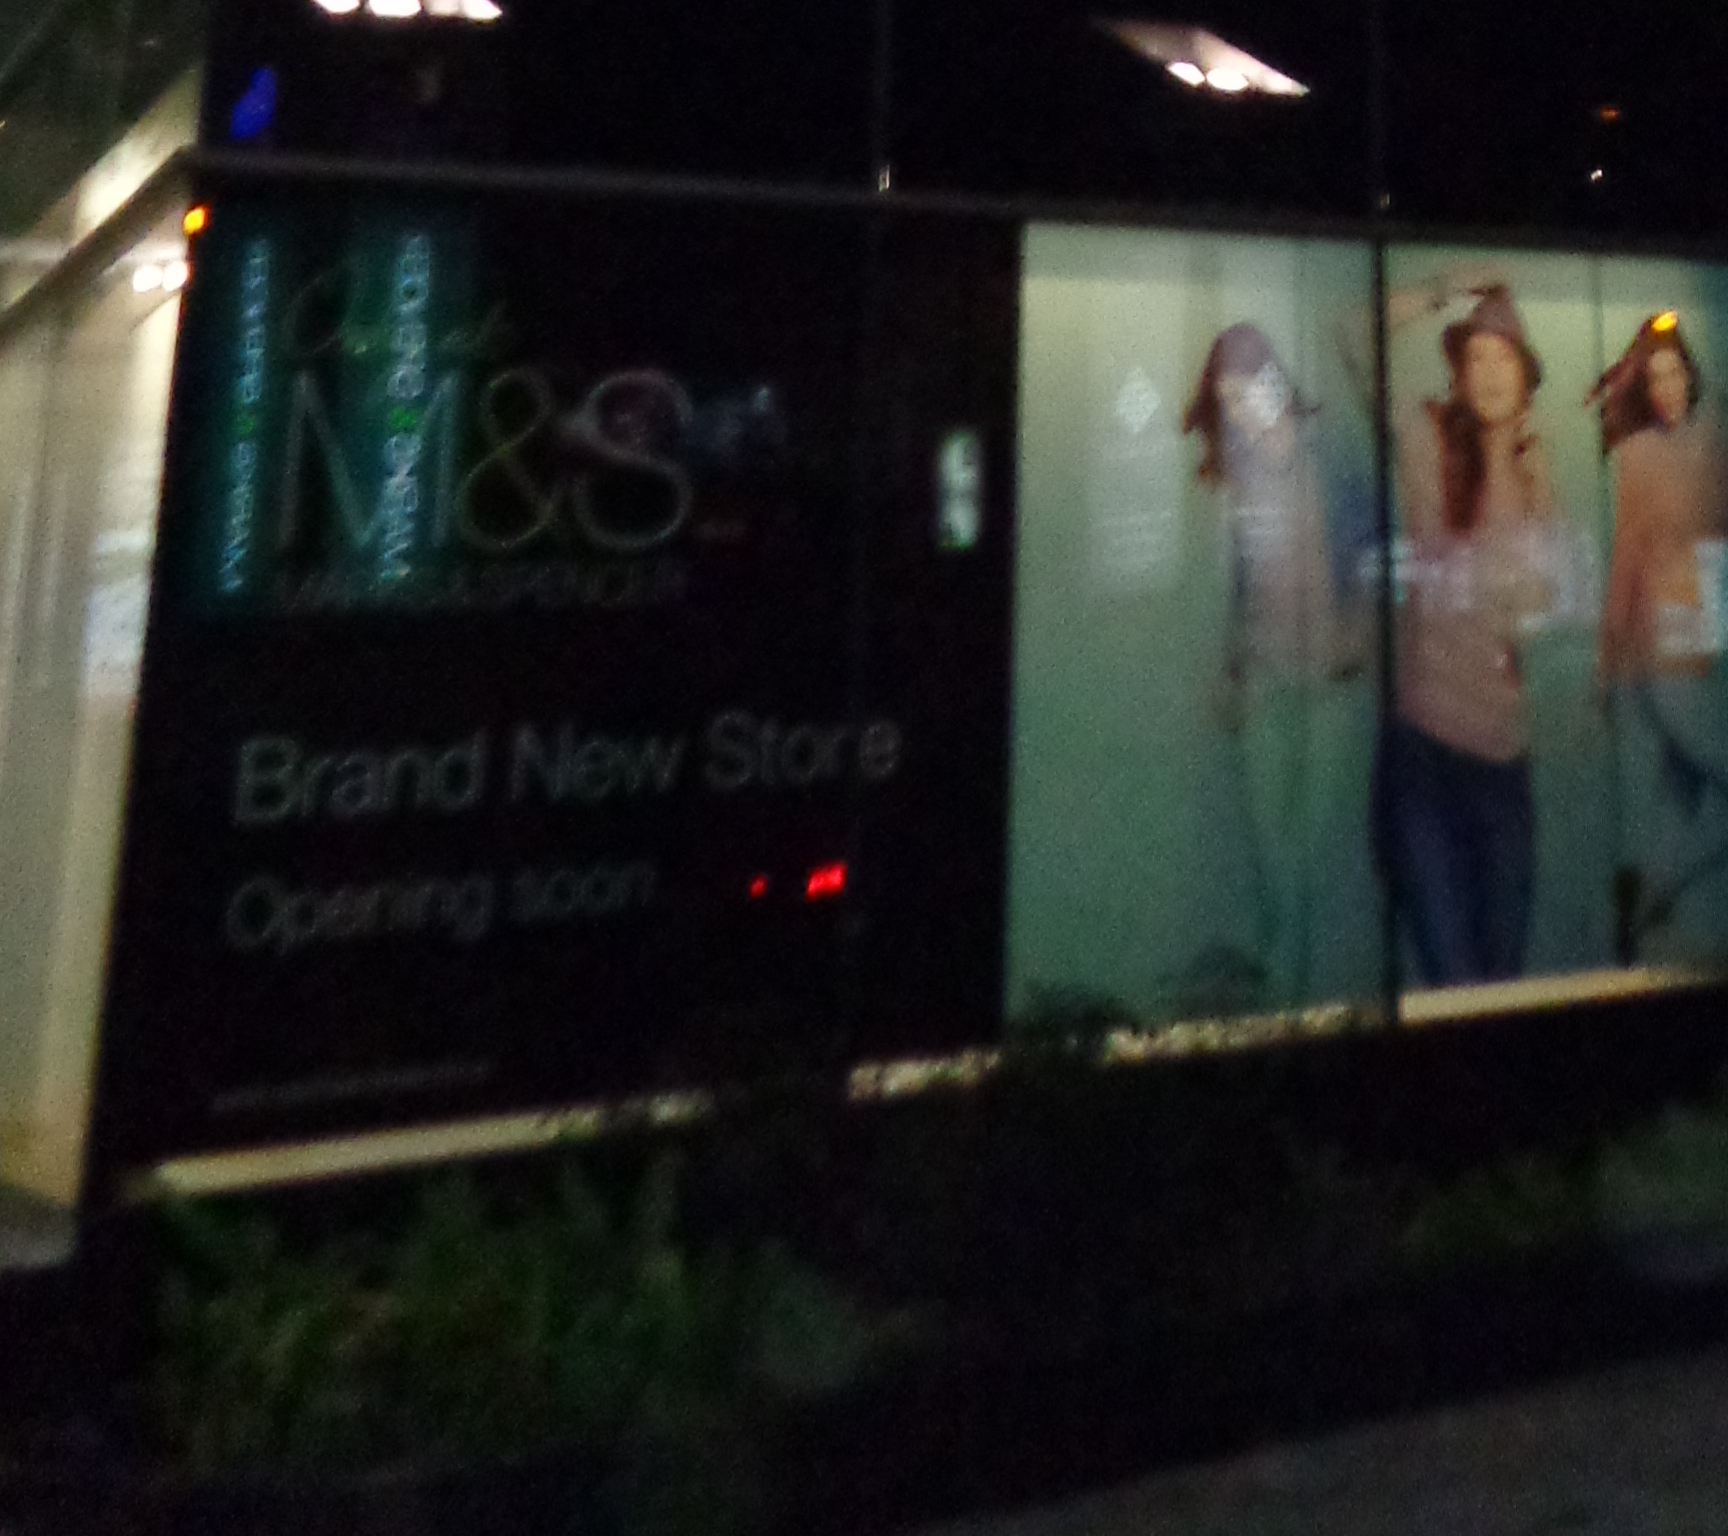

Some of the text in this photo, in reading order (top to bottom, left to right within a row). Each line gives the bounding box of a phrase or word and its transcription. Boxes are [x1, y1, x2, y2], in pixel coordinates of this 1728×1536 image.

[230, 708, 907, 829] Brand New Store
